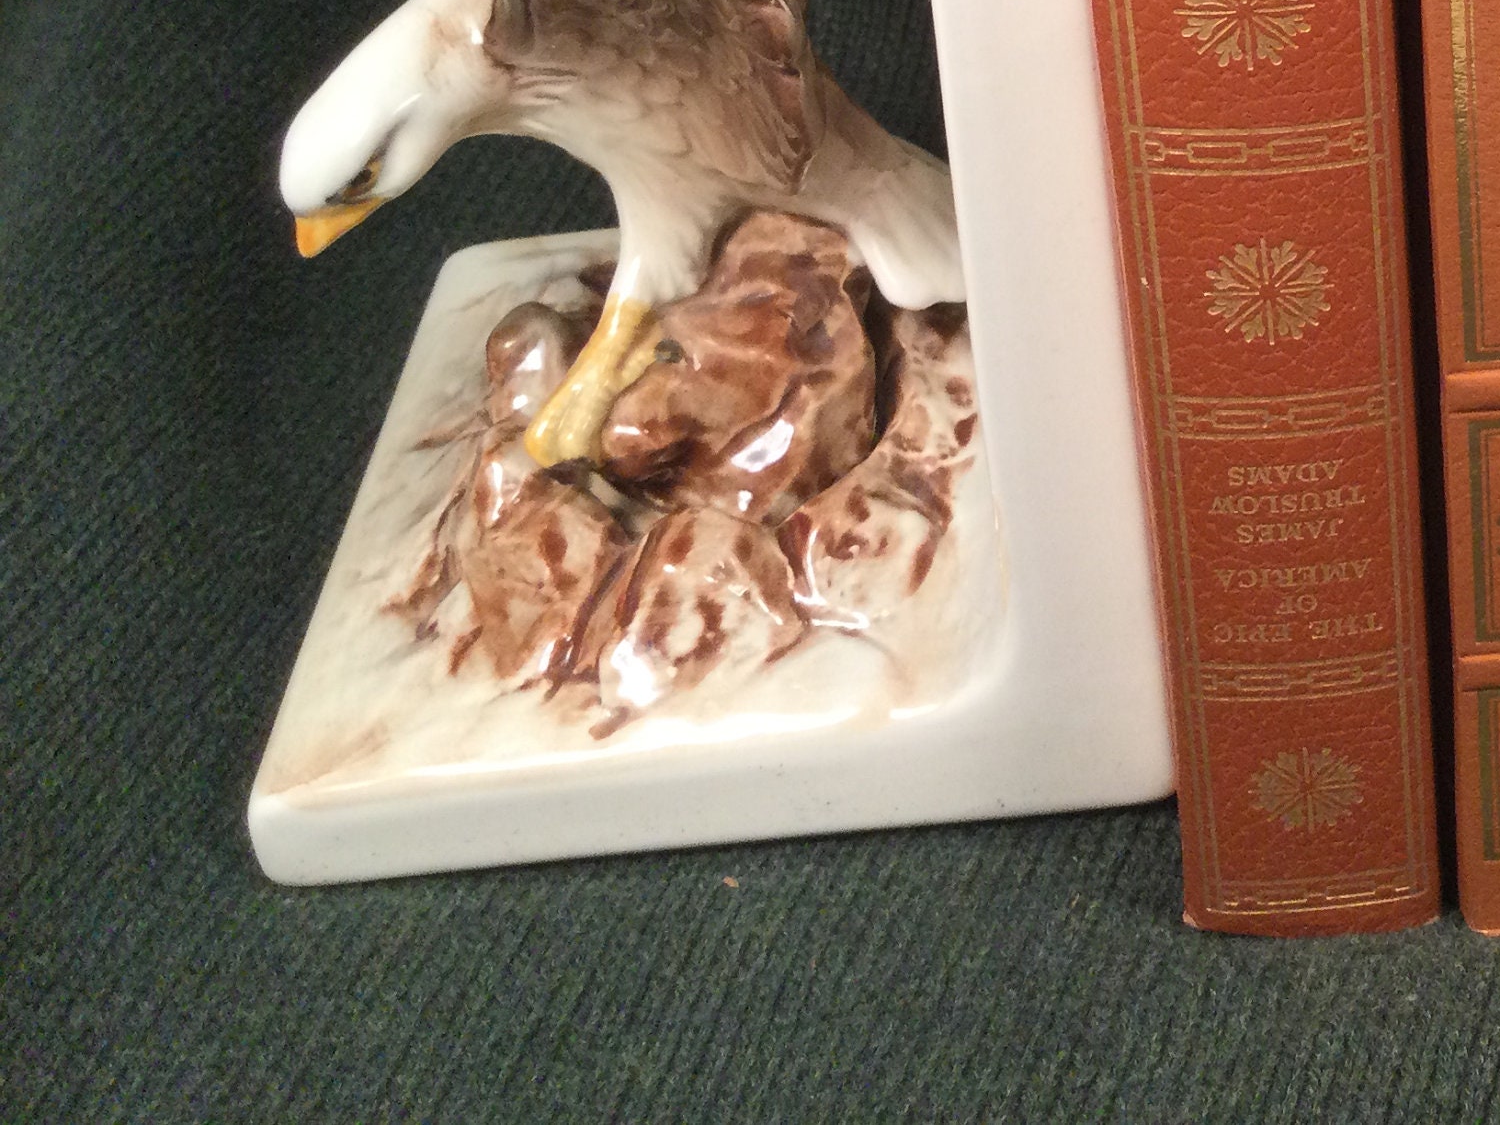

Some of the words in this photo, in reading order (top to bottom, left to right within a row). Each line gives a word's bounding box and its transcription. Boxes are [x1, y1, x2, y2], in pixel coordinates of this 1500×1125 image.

[1227, 458, 1344, 486] ADAMS
[1208, 485, 1366, 515] TRUSLOW
[1236, 518, 1344, 544] JAMES
[1214, 558, 1372, 593] AMERICA
[1276, 594, 1318, 615] OF
[1213, 623, 1293, 643] EPIC
[1308, 613, 1383, 640] THE
